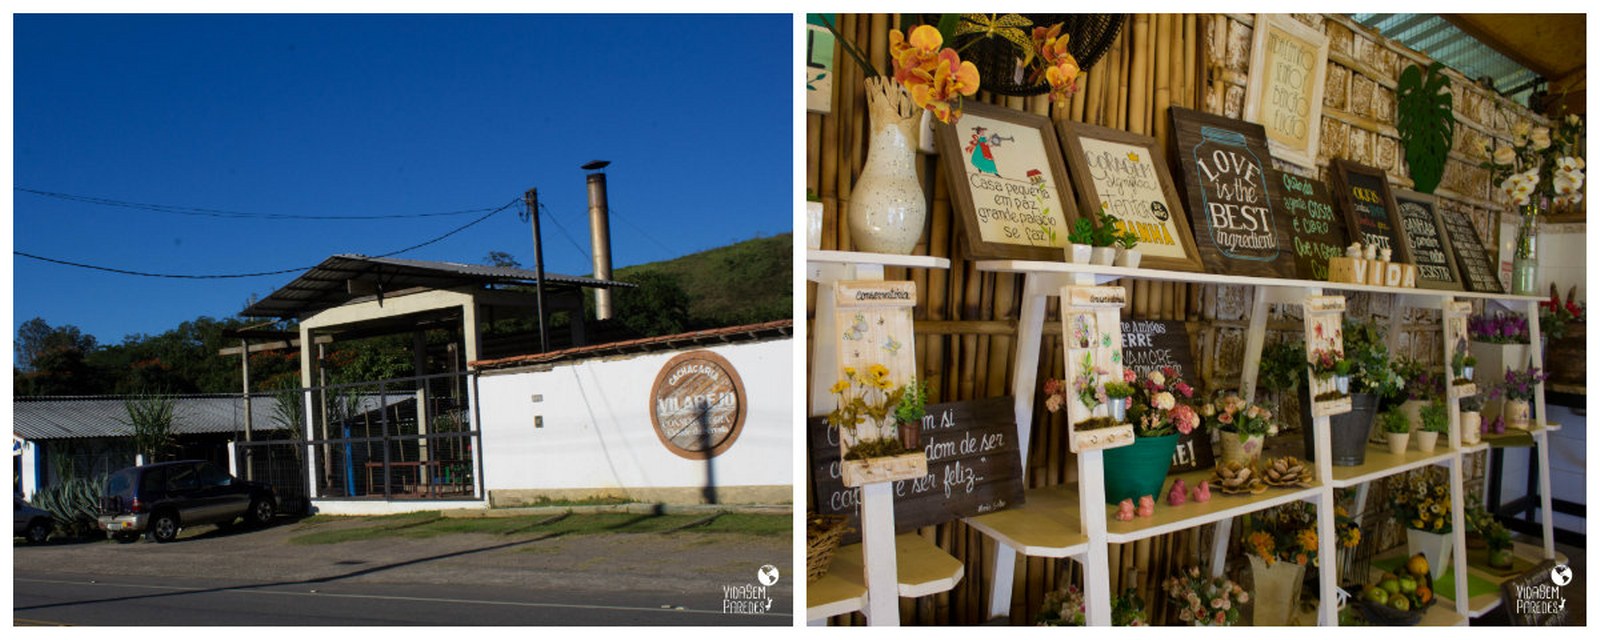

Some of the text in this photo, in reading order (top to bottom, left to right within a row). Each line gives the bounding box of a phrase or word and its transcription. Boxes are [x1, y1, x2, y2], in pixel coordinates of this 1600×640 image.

[1198, 150, 1260, 187] LOVE
[970, 173, 1050, 199] Casa pequena
[1215, 178, 1258, 204] is the
[994, 194, 1038, 210] em paz
[978, 207, 1019, 224] grande
[1207, 202, 1268, 232] BEST
[1003, 226, 1046, 246] se faz
[1216, 228, 1277, 252] ingredient
[1353, 259, 1416, 288] VIDA
[940, 408, 956, 429] si
[925, 431, 1005, 461] dom de ser
[911, 475, 938, 493] ser
